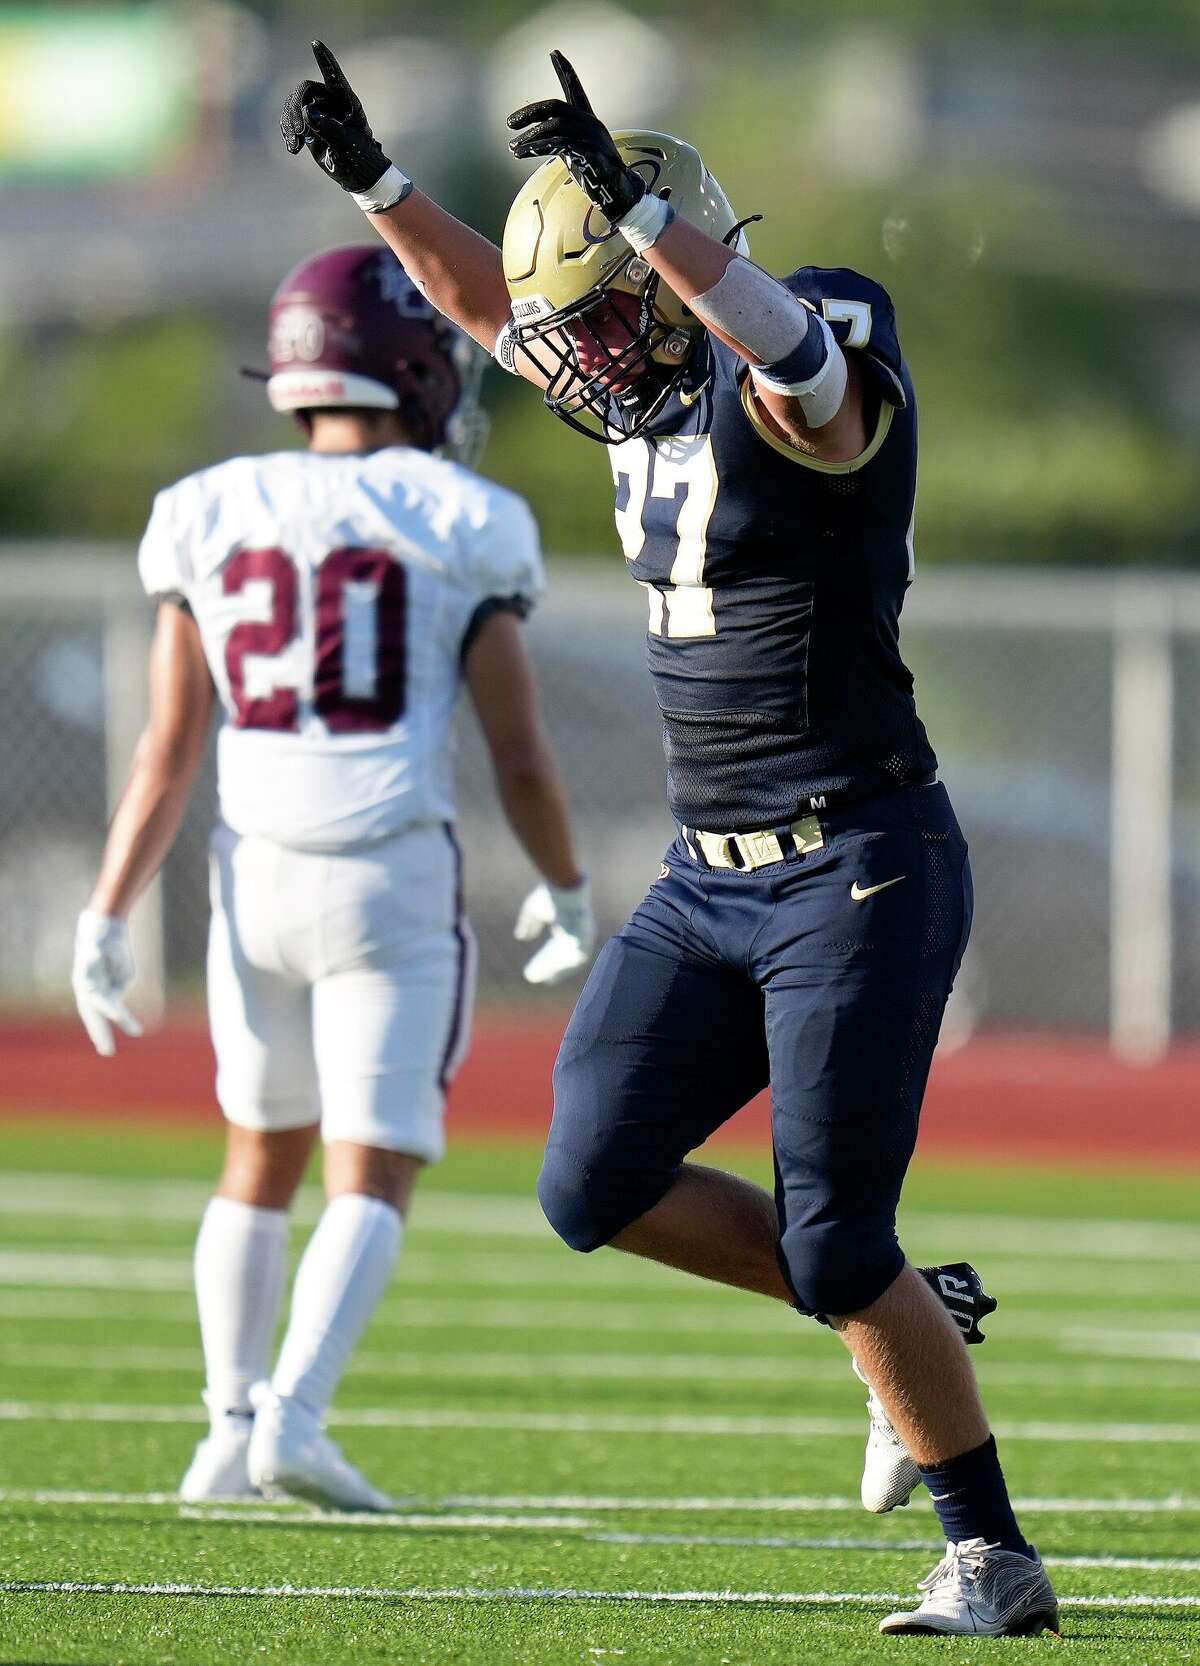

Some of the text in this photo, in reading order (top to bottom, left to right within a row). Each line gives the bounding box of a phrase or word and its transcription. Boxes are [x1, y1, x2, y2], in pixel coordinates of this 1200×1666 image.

[797, 298, 872, 349] 7
[223, 547, 408, 733] 20
[810, 796, 826, 809] M
